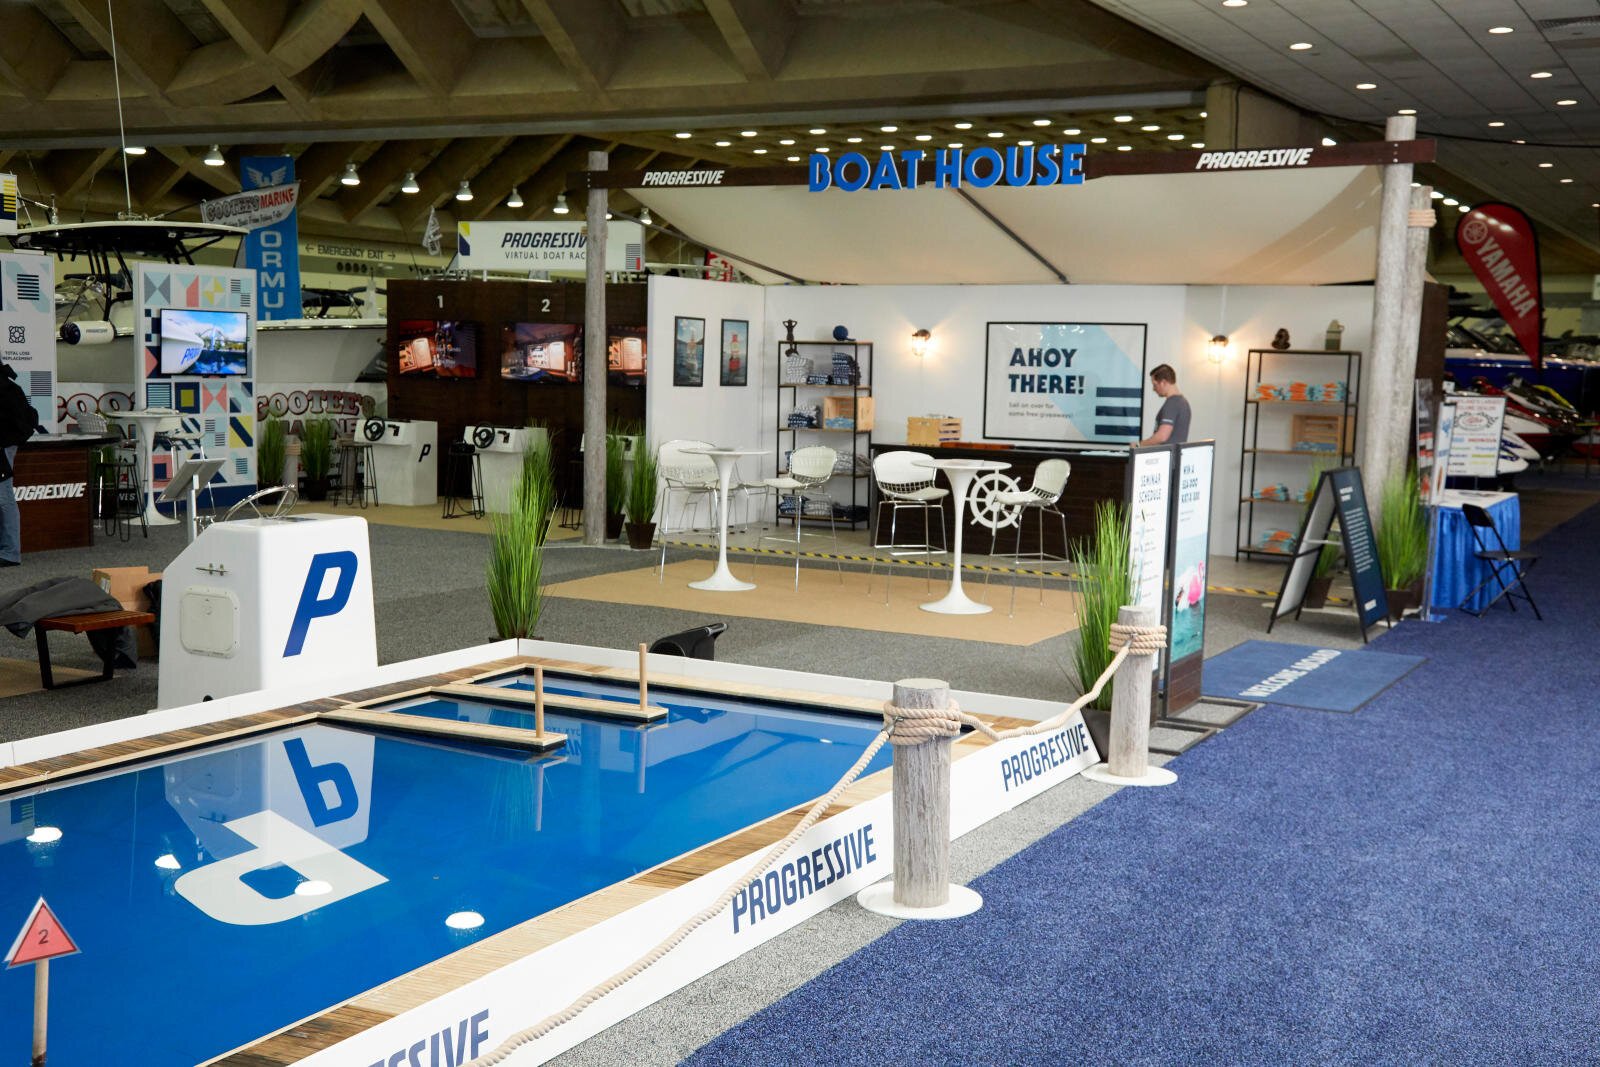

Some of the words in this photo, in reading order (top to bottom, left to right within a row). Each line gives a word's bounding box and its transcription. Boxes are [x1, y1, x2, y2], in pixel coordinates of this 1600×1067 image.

[809, 151, 924, 192] BOAT
[936, 143, 1087, 189] HOUSE
[1196, 148, 1314, 170] PROGRESSIVE
[642, 169, 725, 187] PROGRESSIVE
[259, 188, 294, 209] MARINE
[501, 232, 587, 248] PROGRESSIV
[317, 244, 364, 257] EMERGENCY
[367, 249, 384, 259] EXIT
[504, 251, 539, 260] VIRTUAL
[543, 251, 565, 260] BOAT
[569, 251, 586, 260] RAC
[1476, 237, 1537, 318] YAMAHA
[437, 295, 444, 308] 1
[541, 299, 550, 313] 2
[1009, 347, 1078, 368] AHOY
[1008, 374, 1085, 395] THERE!
[418, 444, 431, 462] P
[13, 482, 87, 501] OGRESSIVE
[285, 550, 358, 656] P
[1001, 723, 1089, 792] PROGRESSIVE
[732, 823, 877, 935] PROGRESSIVE
[38, 928, 49, 945] 2
